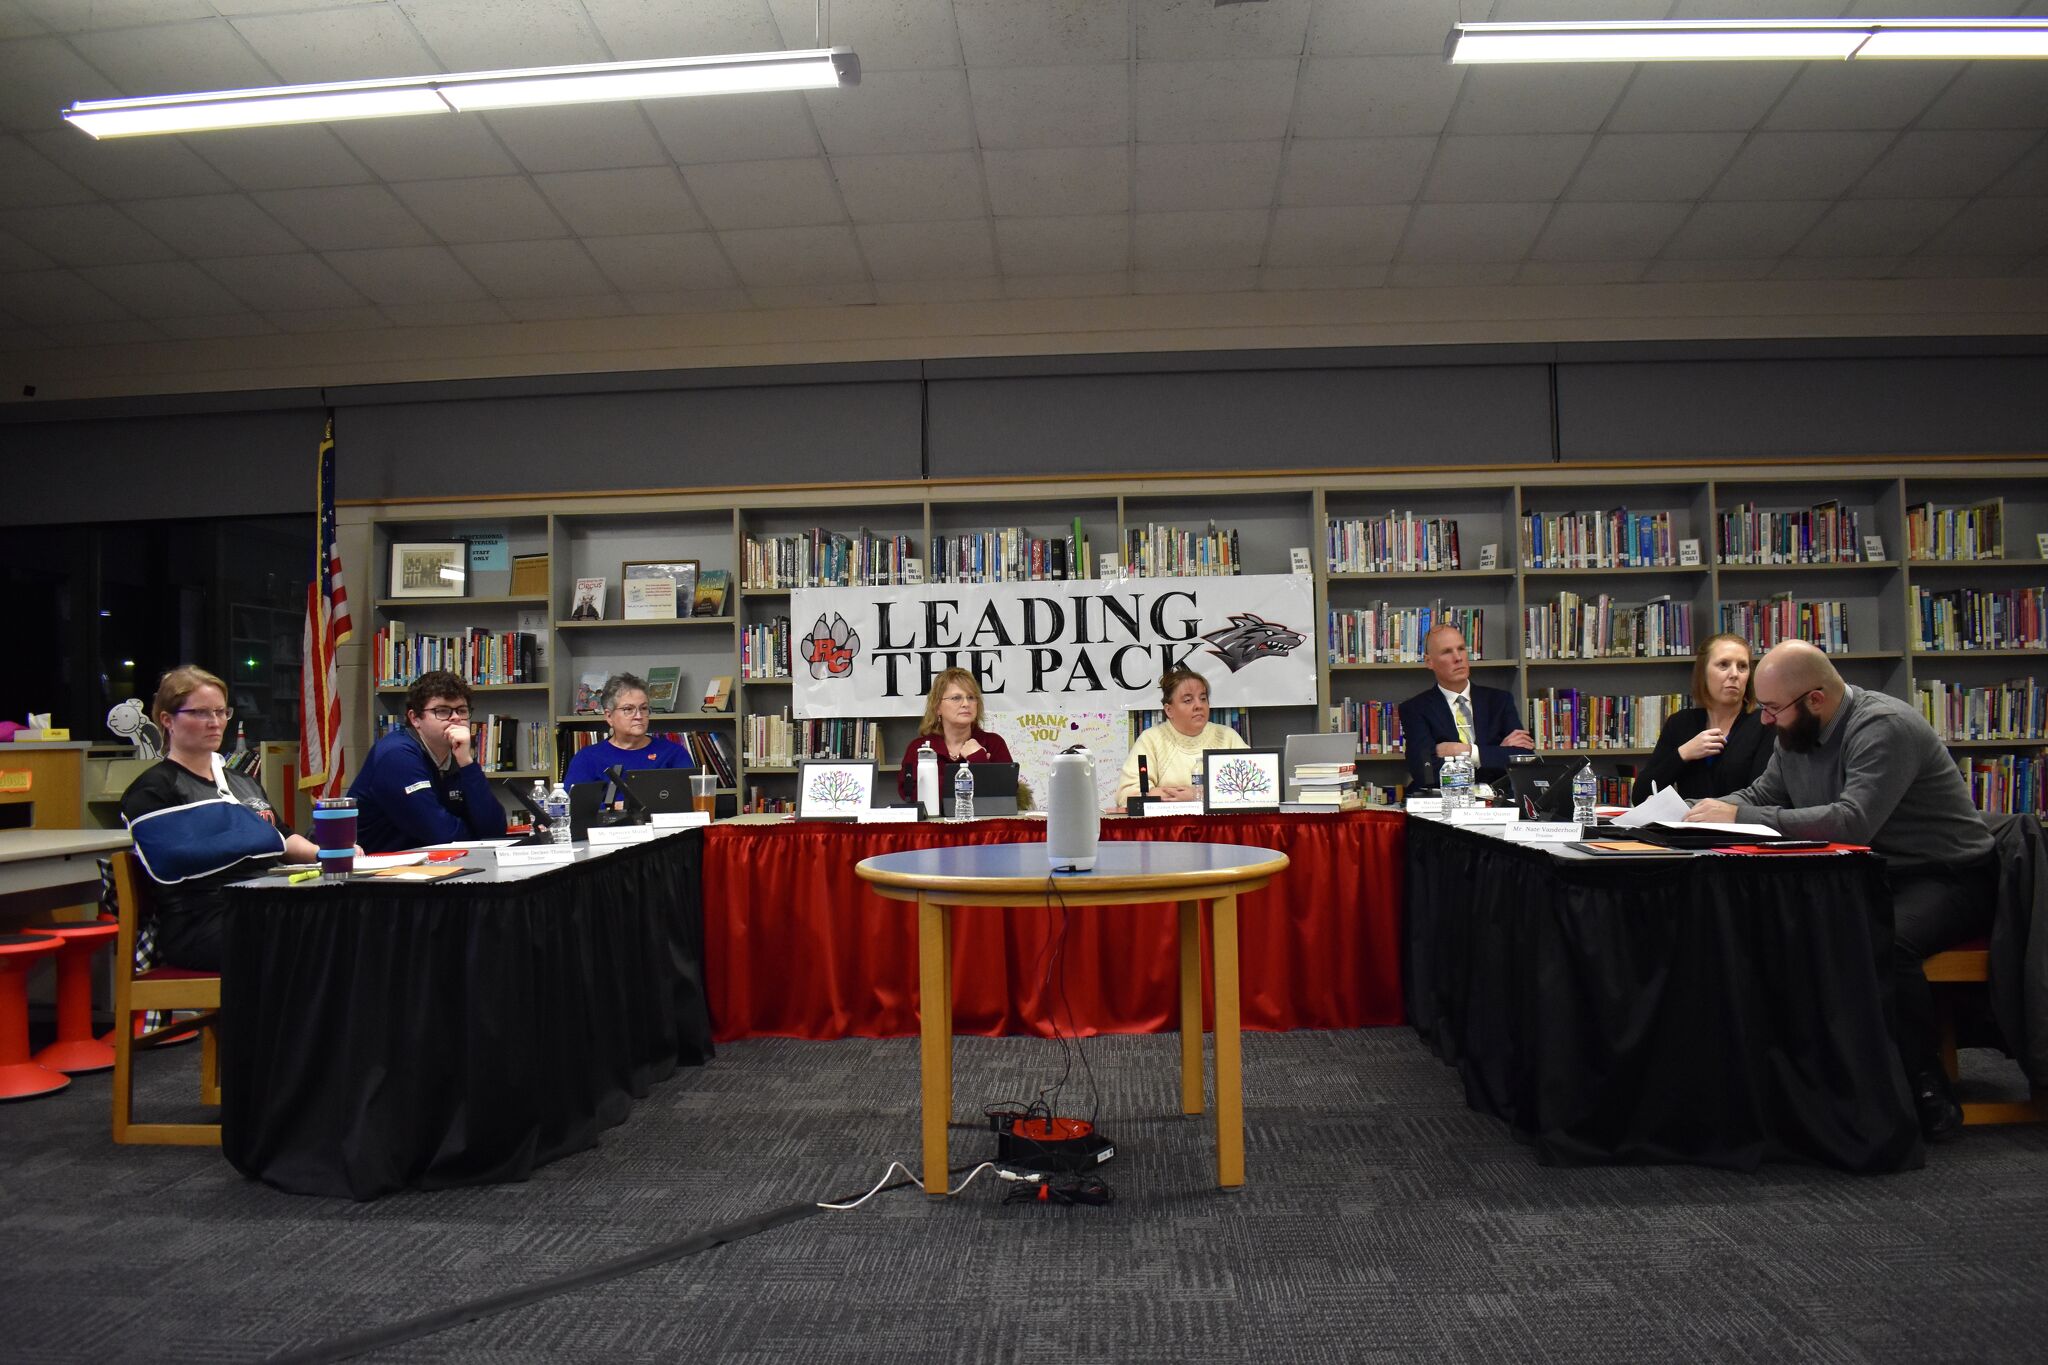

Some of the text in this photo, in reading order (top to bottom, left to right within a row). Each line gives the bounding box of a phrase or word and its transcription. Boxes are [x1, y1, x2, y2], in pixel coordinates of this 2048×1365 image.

[872, 591, 1203, 650] LEADING
[810, 638, 853, 673] RC
[872, 650, 1006, 697] THE
[1026, 643, 1204, 693] PACK
[1017, 714, 1068, 728] THANK
[1030, 729, 1060, 742] YOU
